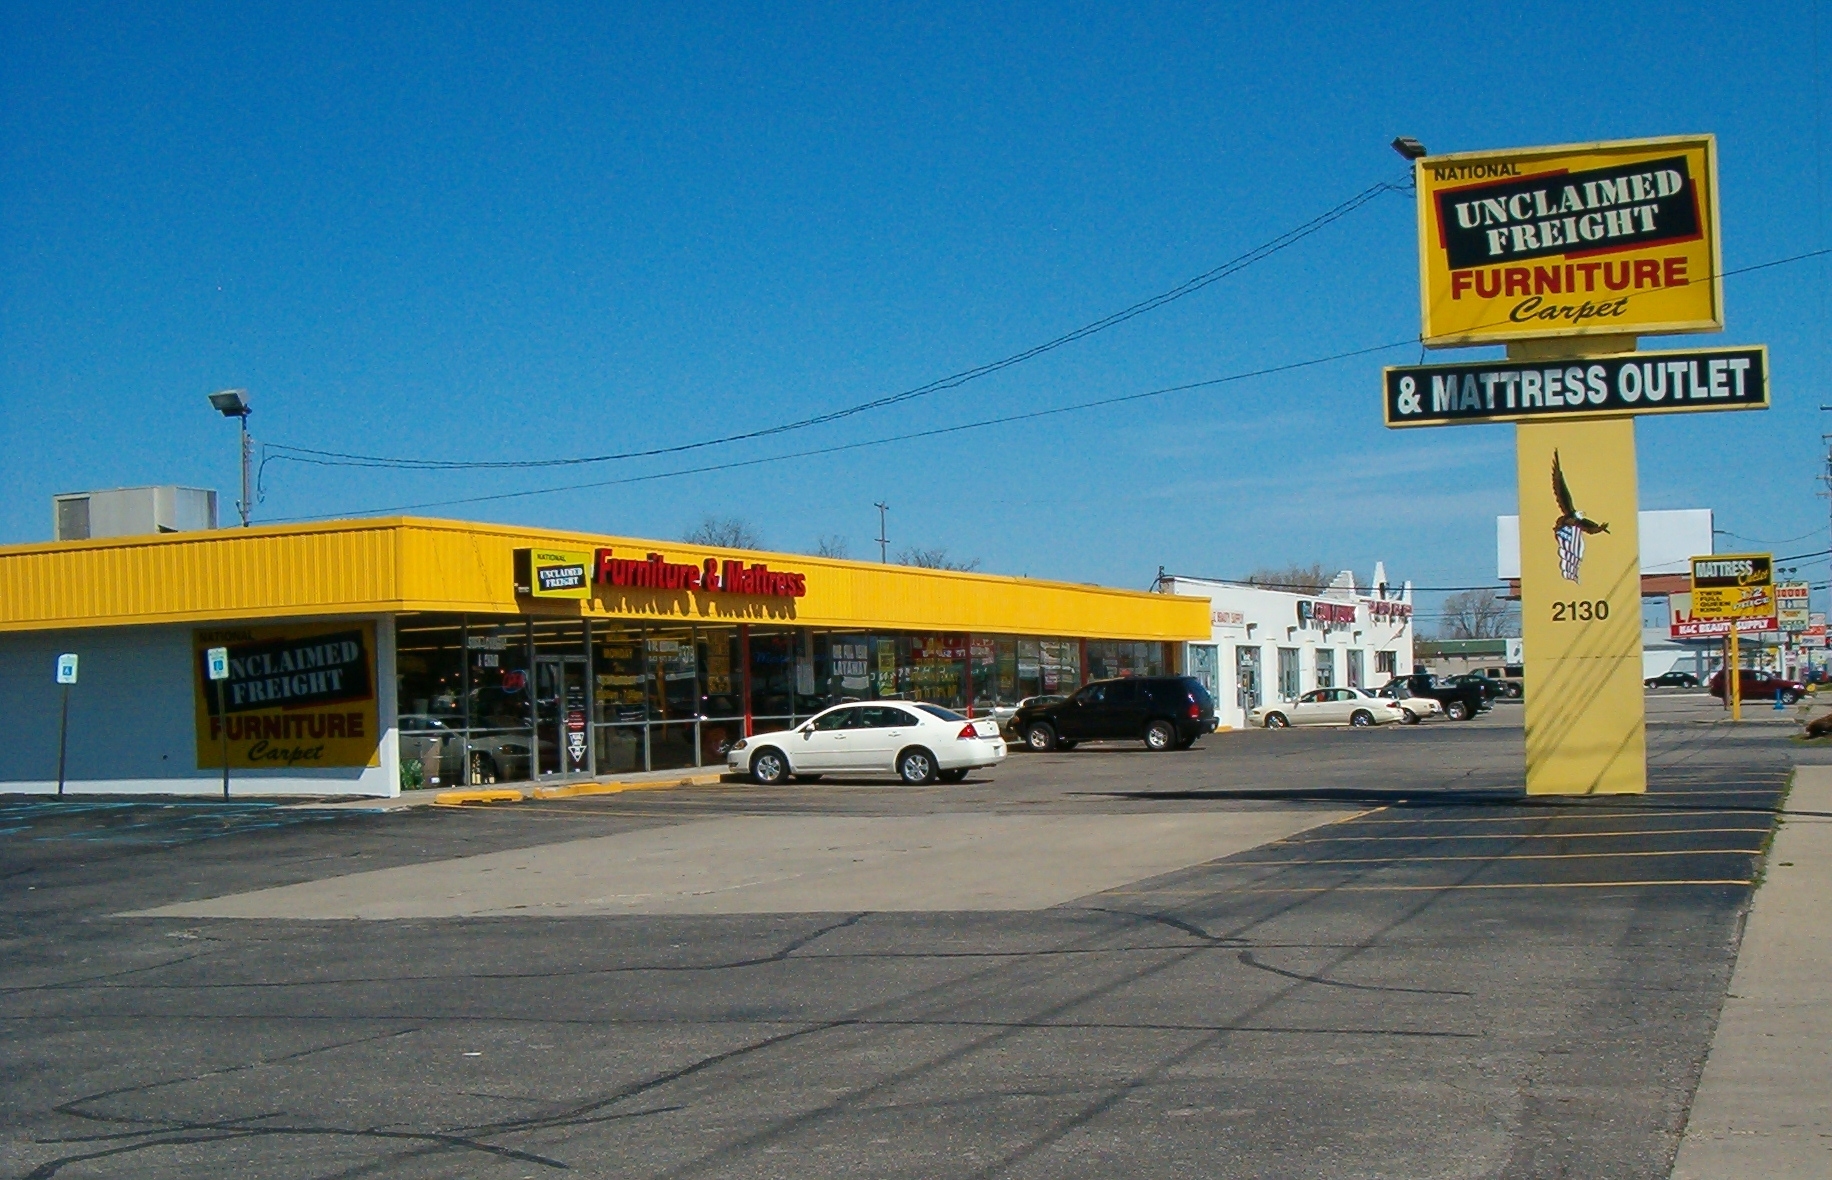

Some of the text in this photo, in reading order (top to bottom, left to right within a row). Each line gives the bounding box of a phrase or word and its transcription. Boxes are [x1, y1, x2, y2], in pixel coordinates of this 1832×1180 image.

[1434, 163, 1521, 181] NATIONAL
[1455, 169, 1683, 228] UNCLAIMED
[1486, 204, 1659, 255] FREIGHT
[1451, 256, 1690, 300] FURNITURE
[1509, 296, 1628, 324] Carpet
[1397, 358, 1750, 414] & MATTRESS OUTLET
[537, 553, 567, 562] NATIONAL
[1696, 560, 1753, 578] MATTRESS
[539, 567, 583, 579] UNCLAIMED
[545, 576, 579, 588] FREIGHT
[595, 548, 806, 597] Furniture & Mattress
[1738, 569, 1769, 586] Outlet
[1552, 600, 1609, 622] 2130
[230, 640, 359, 680] NCLAIMED
[232, 668, 343, 705] FREIGHT
[210, 712, 365, 741] FURNITURE
[248, 740, 324, 766] Carpet
